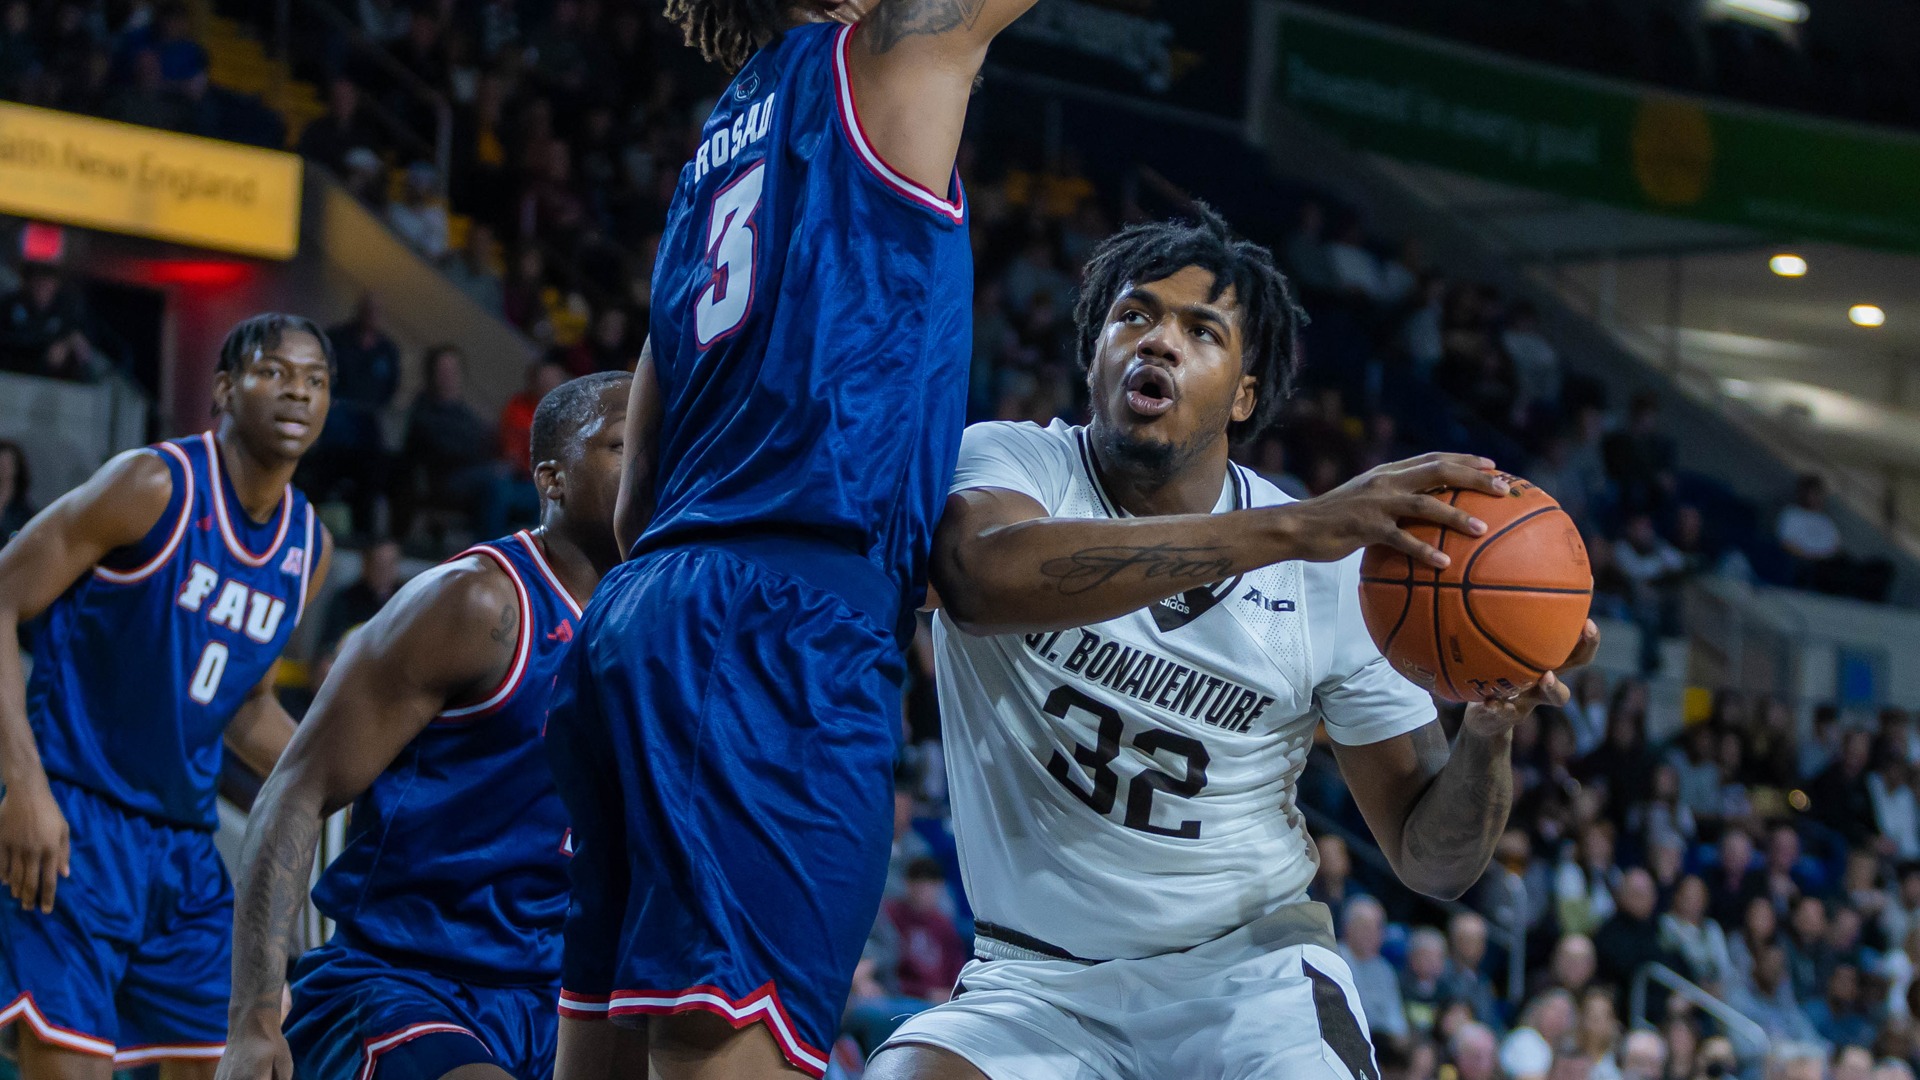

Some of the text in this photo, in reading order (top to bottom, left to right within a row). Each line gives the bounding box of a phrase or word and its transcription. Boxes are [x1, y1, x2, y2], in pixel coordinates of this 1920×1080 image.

[694, 158, 765, 351] 3
[177, 561, 286, 643] FAU
[1159, 598, 1190, 614] didas
[189, 641, 229, 705] 0
[1062, 627, 1276, 734] BONAVENTURE
[1043, 684, 1211, 840] 32
